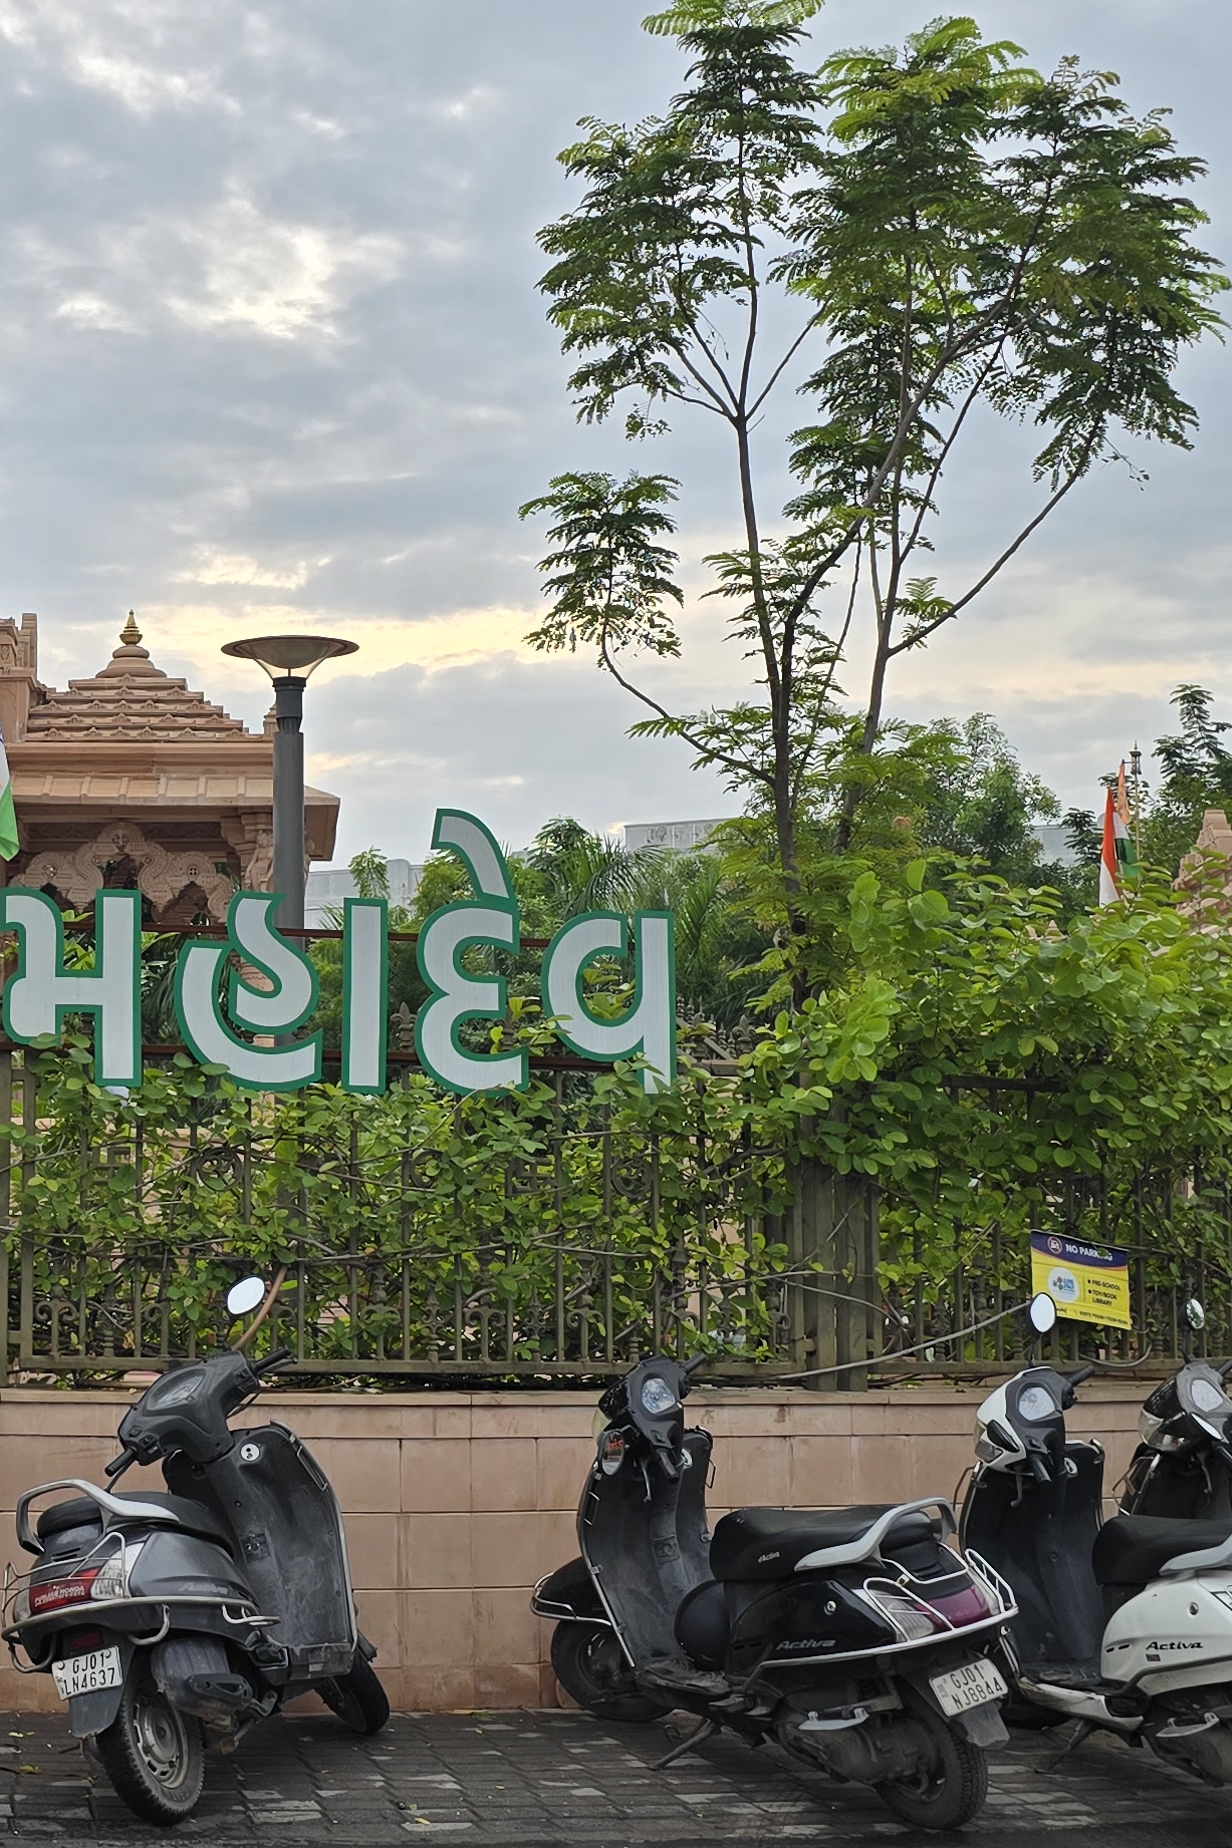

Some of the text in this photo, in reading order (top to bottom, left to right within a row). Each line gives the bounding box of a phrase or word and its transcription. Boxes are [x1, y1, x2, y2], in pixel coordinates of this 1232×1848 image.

[1065, 1243, 1078, 1254] NO
[776, 1639, 836, 1650] Activa
[1145, 1641, 1203, 1651] Activa
[72, 1651, 105, 1674] GJ01
[63, 1667, 116, 1696] LN4637
[949, 1663, 985, 1689] GJ01
[950, 1676, 1004, 1710] NJ8844
